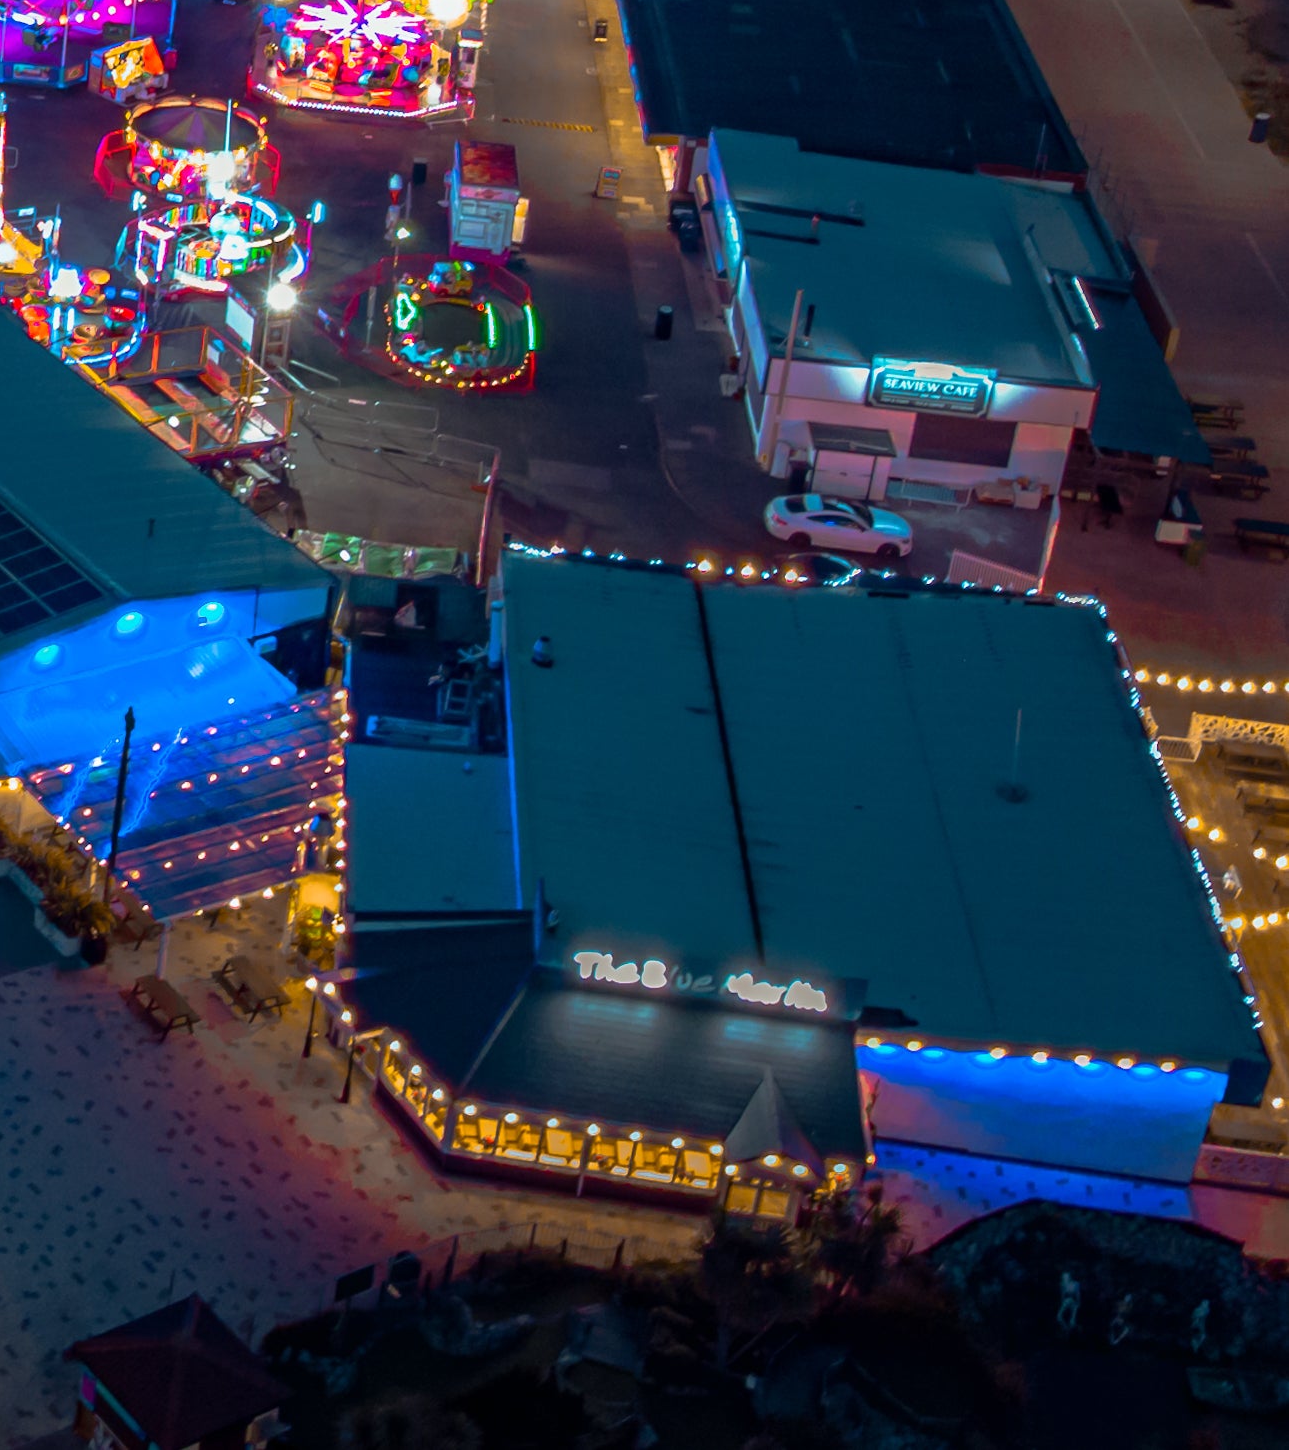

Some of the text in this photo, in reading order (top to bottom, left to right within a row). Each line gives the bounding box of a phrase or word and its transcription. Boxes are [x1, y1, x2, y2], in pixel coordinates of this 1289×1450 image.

[883, 378, 978, 398] SEAVIEW CAFE
[573, 951, 640, 984] The
[641, 959, 716, 992] Blue
